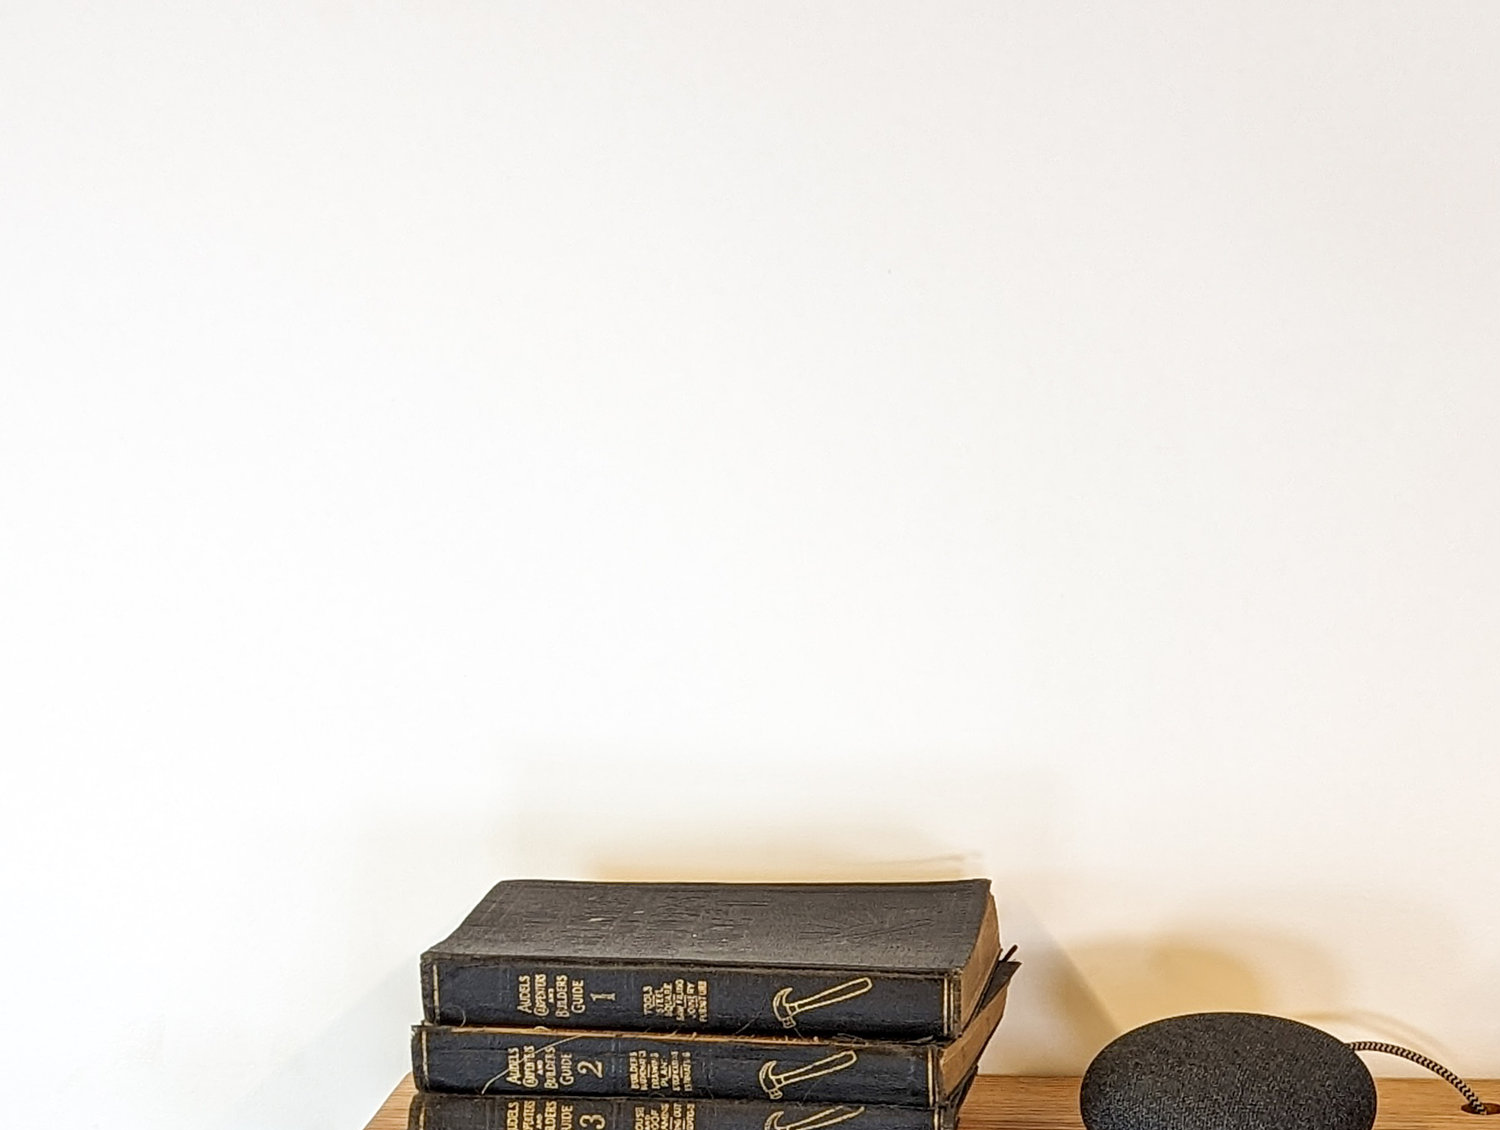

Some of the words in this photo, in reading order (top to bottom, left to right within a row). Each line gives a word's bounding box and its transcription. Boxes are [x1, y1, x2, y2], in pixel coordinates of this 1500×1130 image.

[517, 975, 532, 1013] AUDELS
[556, 975, 569, 1017] BUILDERS
[571, 980, 585, 1013] GUIDE
[590, 993, 615, 1002] 1
[643, 986, 653, 1015] TOOLS
[655, 987, 664, 1013] STEEL
[664, 983, 673, 1017] SQUARE
[506, 1047, 521, 1084] AUDELS
[544, 1046, 558, 1089] BUILDERS
[560, 1053, 574, 1085] GUIDE
[577, 1061, 603, 1078] 2
[579, 1114, 605, 1130] 3
[673, 1103, 681, 1118] OUT
